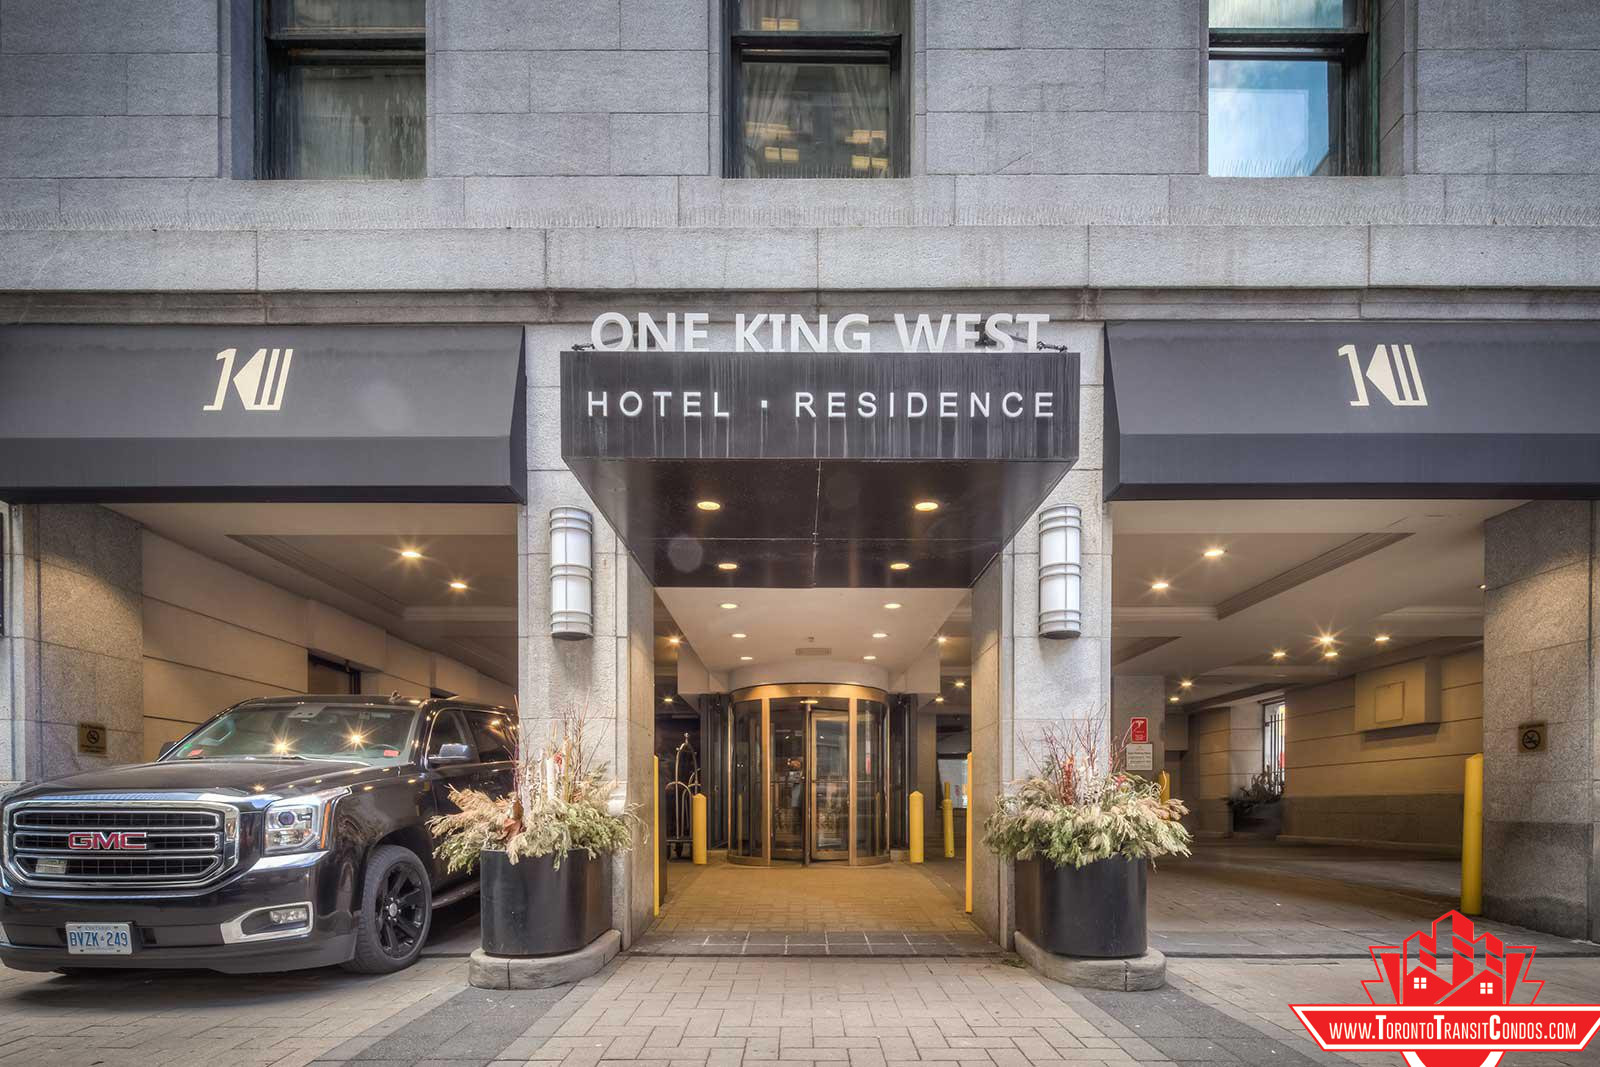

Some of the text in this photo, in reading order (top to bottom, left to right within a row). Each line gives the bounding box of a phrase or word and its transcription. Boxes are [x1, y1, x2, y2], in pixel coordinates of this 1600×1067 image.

[590, 311, 1050, 353] ONE KING WEST
[587, 391, 1054, 418] HOTEL RESIDENCE
[68, 831, 147, 850] GMC
[106, 931, 128, 947] 249
